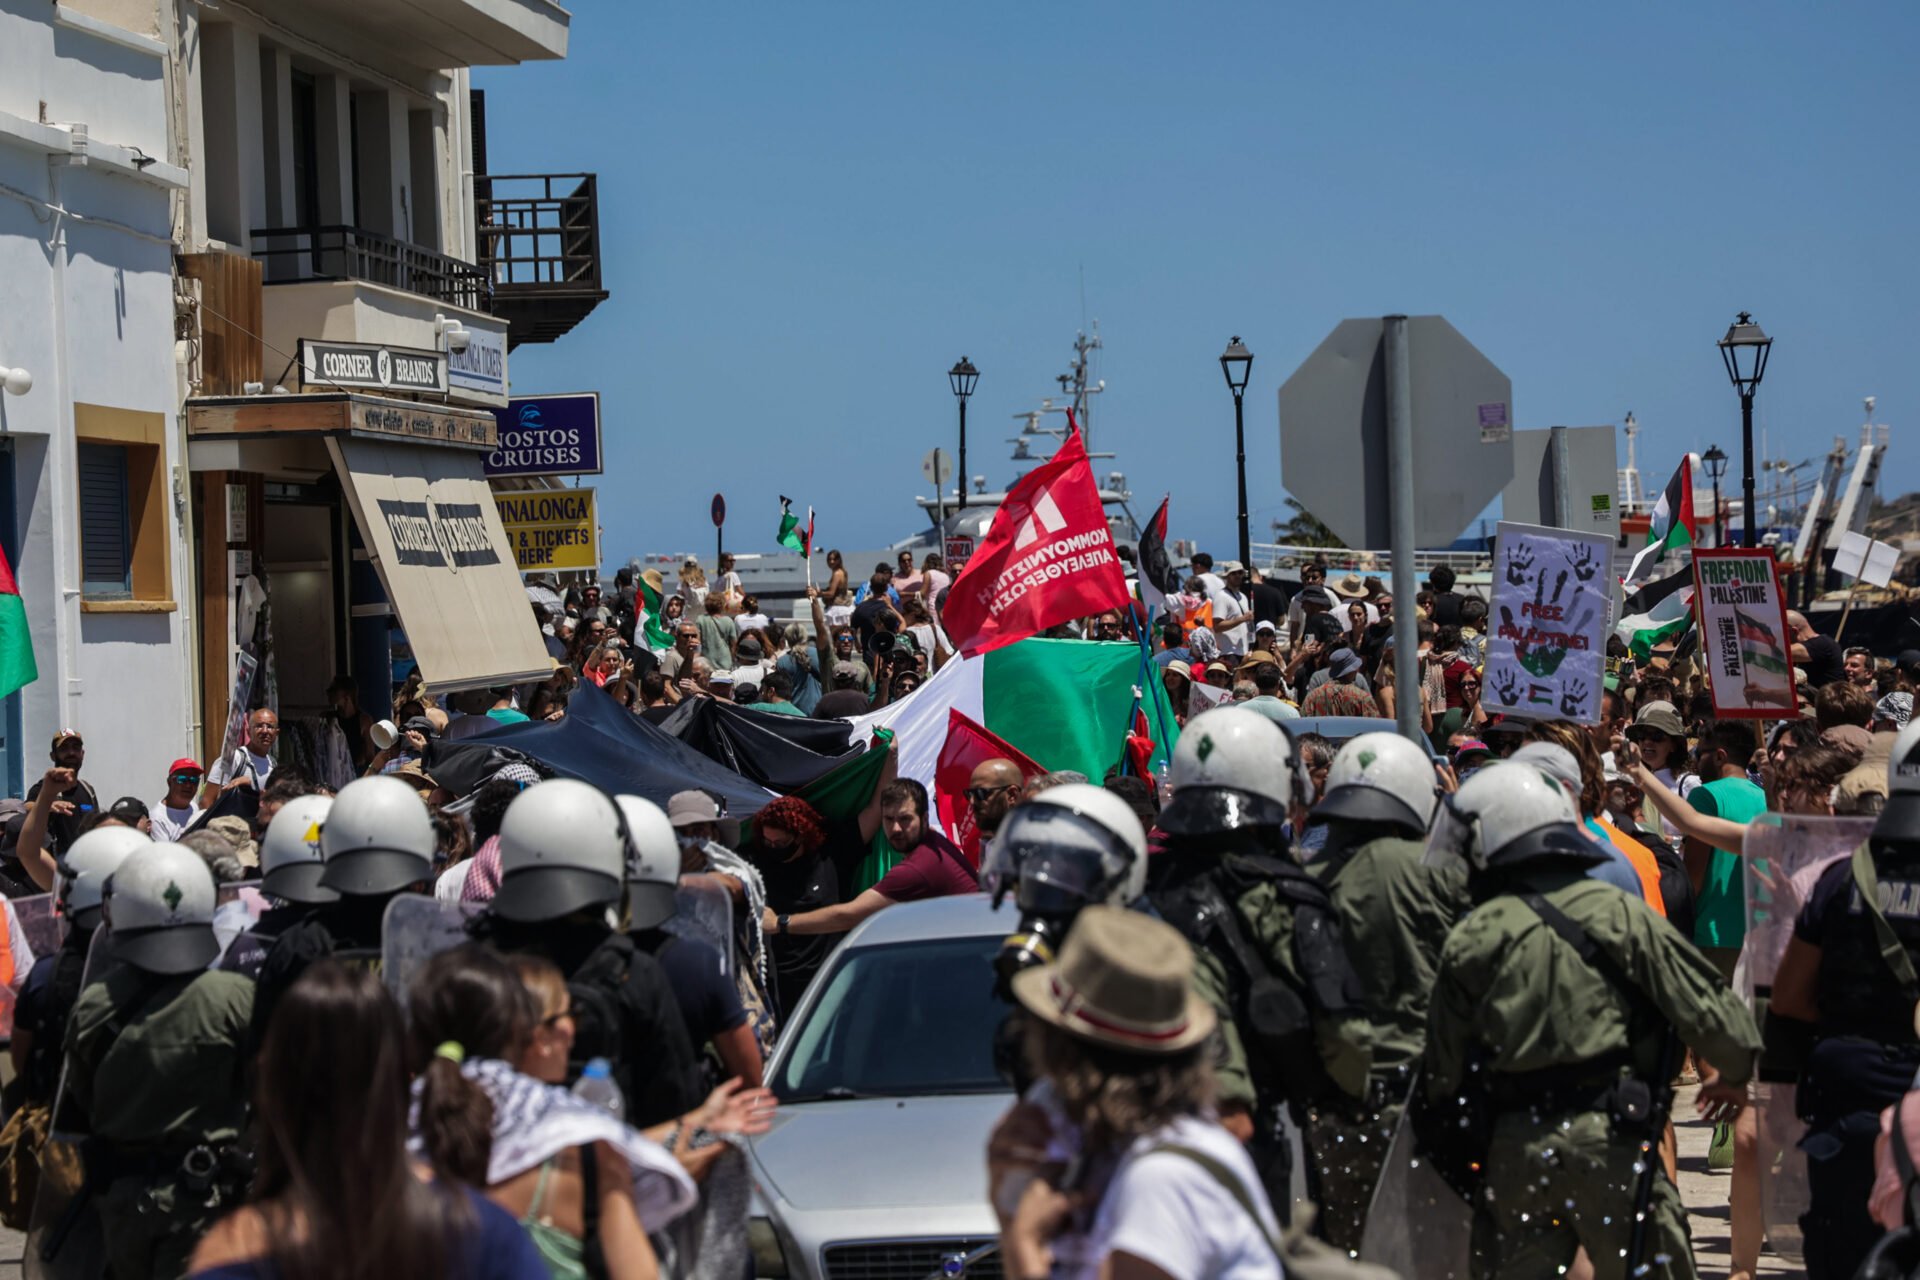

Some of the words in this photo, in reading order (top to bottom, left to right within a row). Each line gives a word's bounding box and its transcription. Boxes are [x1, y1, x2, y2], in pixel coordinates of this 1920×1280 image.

[323, 353, 373, 378] CORNER
[395, 358, 434, 384] BRANDS
[481, 345, 502, 378] TICKETS
[488, 447, 581, 467] CRUISES
[387, 513, 439, 553] CORNER
[440, 516, 492, 553] BRANDS
[519, 531, 529, 547] &
[533, 528, 589, 547] TICKETS
[518, 547, 553, 564] HERE
[1700, 559, 1771, 585] FREEDOM
[1709, 585, 1768, 605] PALESTINE
[1520, 602, 1565, 622] FREE
[1722, 617, 1741, 677] PALESTINE
[1850, 880, 1920, 914] OLI
